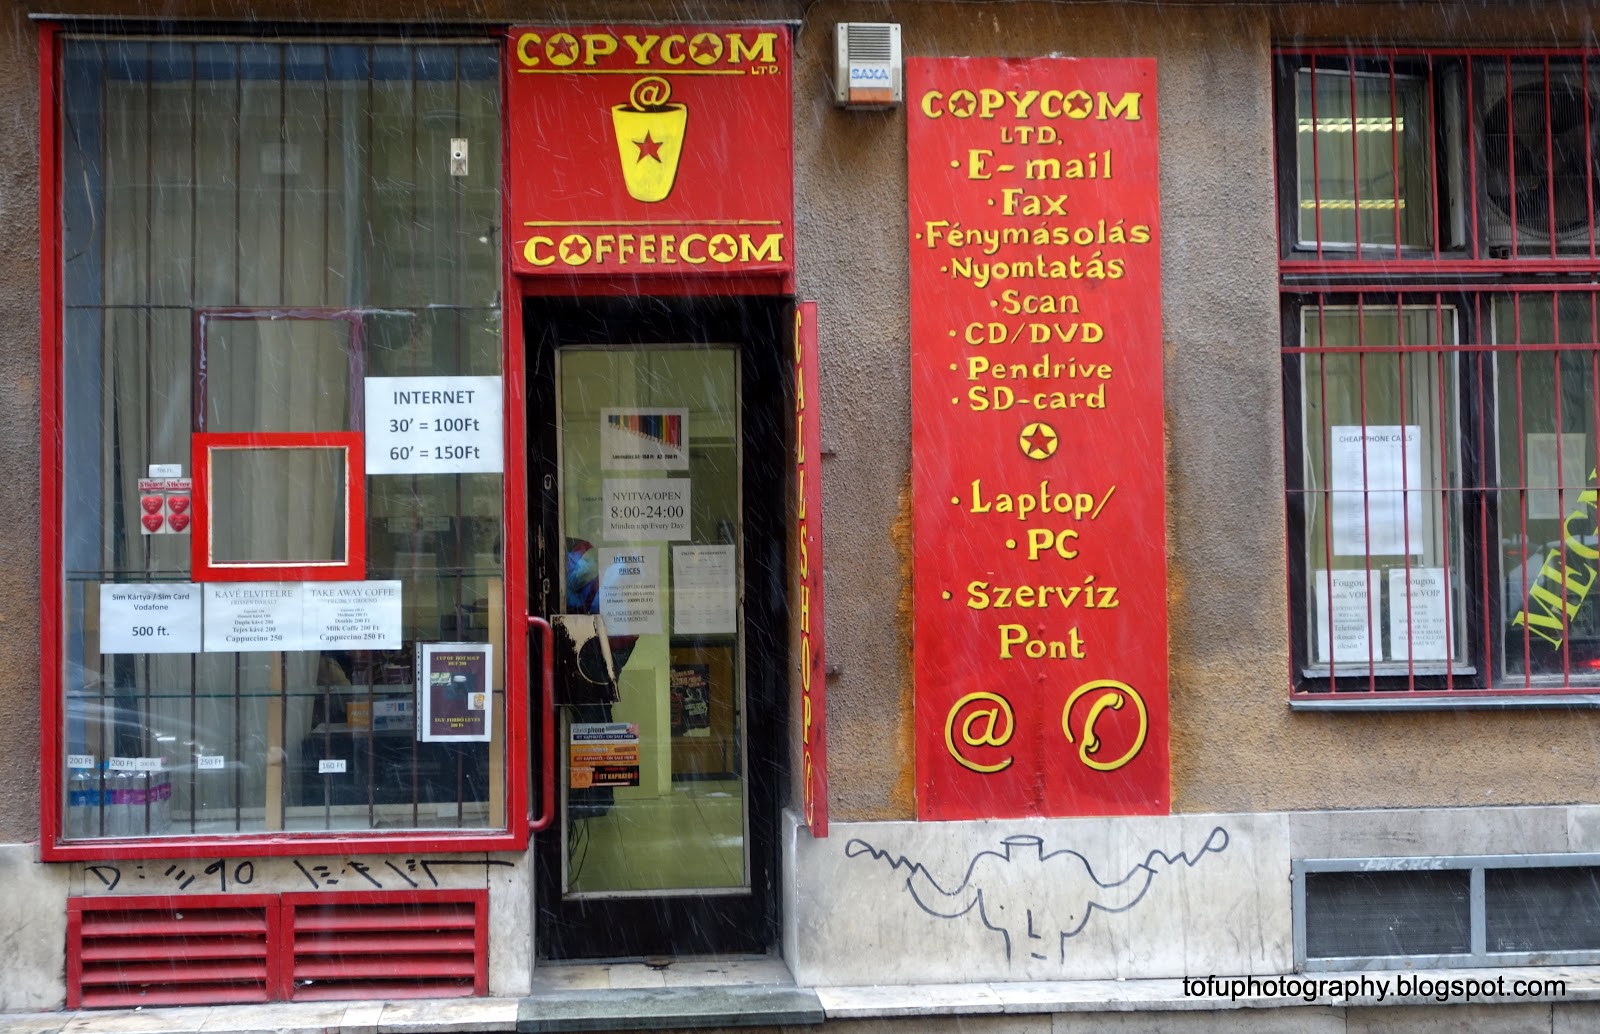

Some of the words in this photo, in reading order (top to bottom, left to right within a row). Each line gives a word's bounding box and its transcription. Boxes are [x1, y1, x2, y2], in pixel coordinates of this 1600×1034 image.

[517, 32, 778, 66] COPYCOM
[751, 65, 781, 76] LTD.
[851, 68, 889, 80] SAXA
[921, 88, 1142, 121] COPYCOM
[1000, 126, 1063, 145] LTD.
[1001, 188, 1068, 216] Fax
[926, 219, 1151, 255] Fénymásolás
[523, 233, 784, 266] COFFEECOM
[951, 251, 1125, 287] Nyomtatás
[1001, 290, 1080, 314] Scan
[965, 322, 1104, 344] CD/DVD
[394, 390, 475, 405] INTERNET
[968, 383, 1106, 411] SD-card
[434, 418, 480, 432] 100Ft
[435, 446, 480, 460] 150Ft
[612, 491, 681, 501] NYITVA/OPEN
[970, 479, 1116, 520] Laptop/
[611, 505, 684, 518] 8:00-24:00
[610, 522, 636, 530] Minden
[670, 521, 684, 530] Day
[1027, 528, 1079, 560] PC
[618, 567, 641, 575] PRICES
[1333, 578, 1364, 588] Fougou
[1408, 578, 1436, 588] ougou
[127, 593, 151, 601] Kártya
[215, 588, 241, 599] KÁVÉ
[243, 589, 293, 598] ELVITELRE
[311, 589, 335, 597] TAKE
[337, 588, 363, 596] AWAY
[365, 588, 394, 596] COFFE
[967, 575, 1119, 609] Szervíz
[1420, 589, 1441, 597] VOIP
[132, 626, 154, 636] 500
[157, 625, 170, 636] ft.
[232, 626, 248, 634] Tejes
[225, 635, 268, 643] Cappuccino
[319, 634, 362, 642] Cappuccino
[998, 624, 1086, 659] Pont
